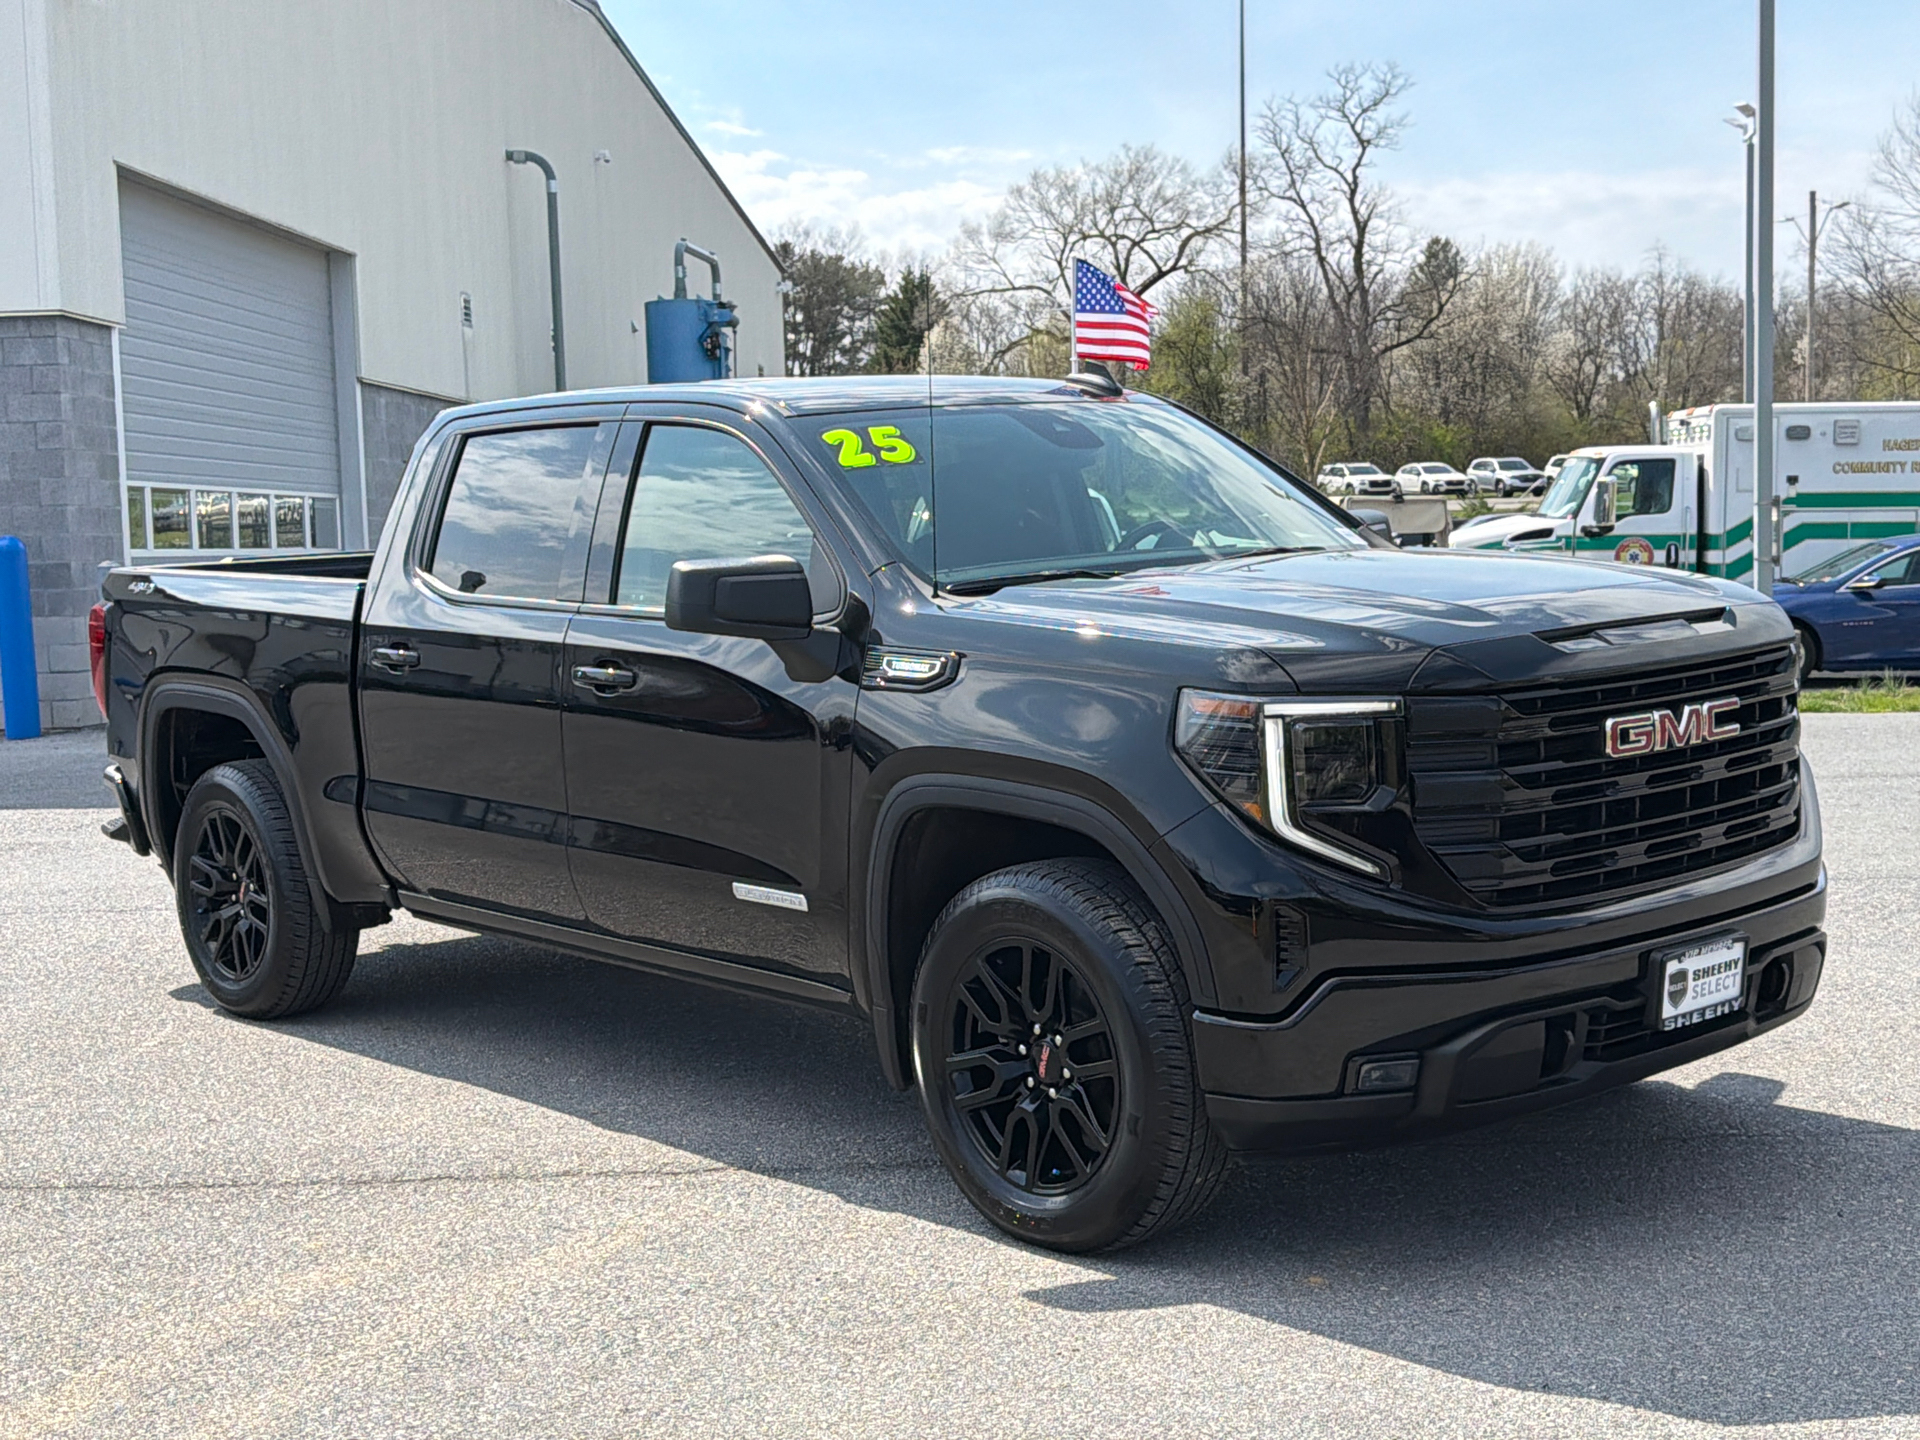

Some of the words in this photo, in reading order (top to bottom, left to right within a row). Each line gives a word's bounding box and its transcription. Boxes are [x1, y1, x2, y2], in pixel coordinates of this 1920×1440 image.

[822, 426, 916, 468] 25
[1832, 461, 1908, 474] COMMUNITY
[1605, 697, 1741, 758] GMC
[1691, 972, 1740, 1000] SELECT
[1692, 957, 1741, 982] SHEEHY
[1664, 998, 1743, 1031] SHEEHY
[1038, 1044, 1050, 1078] GMC
